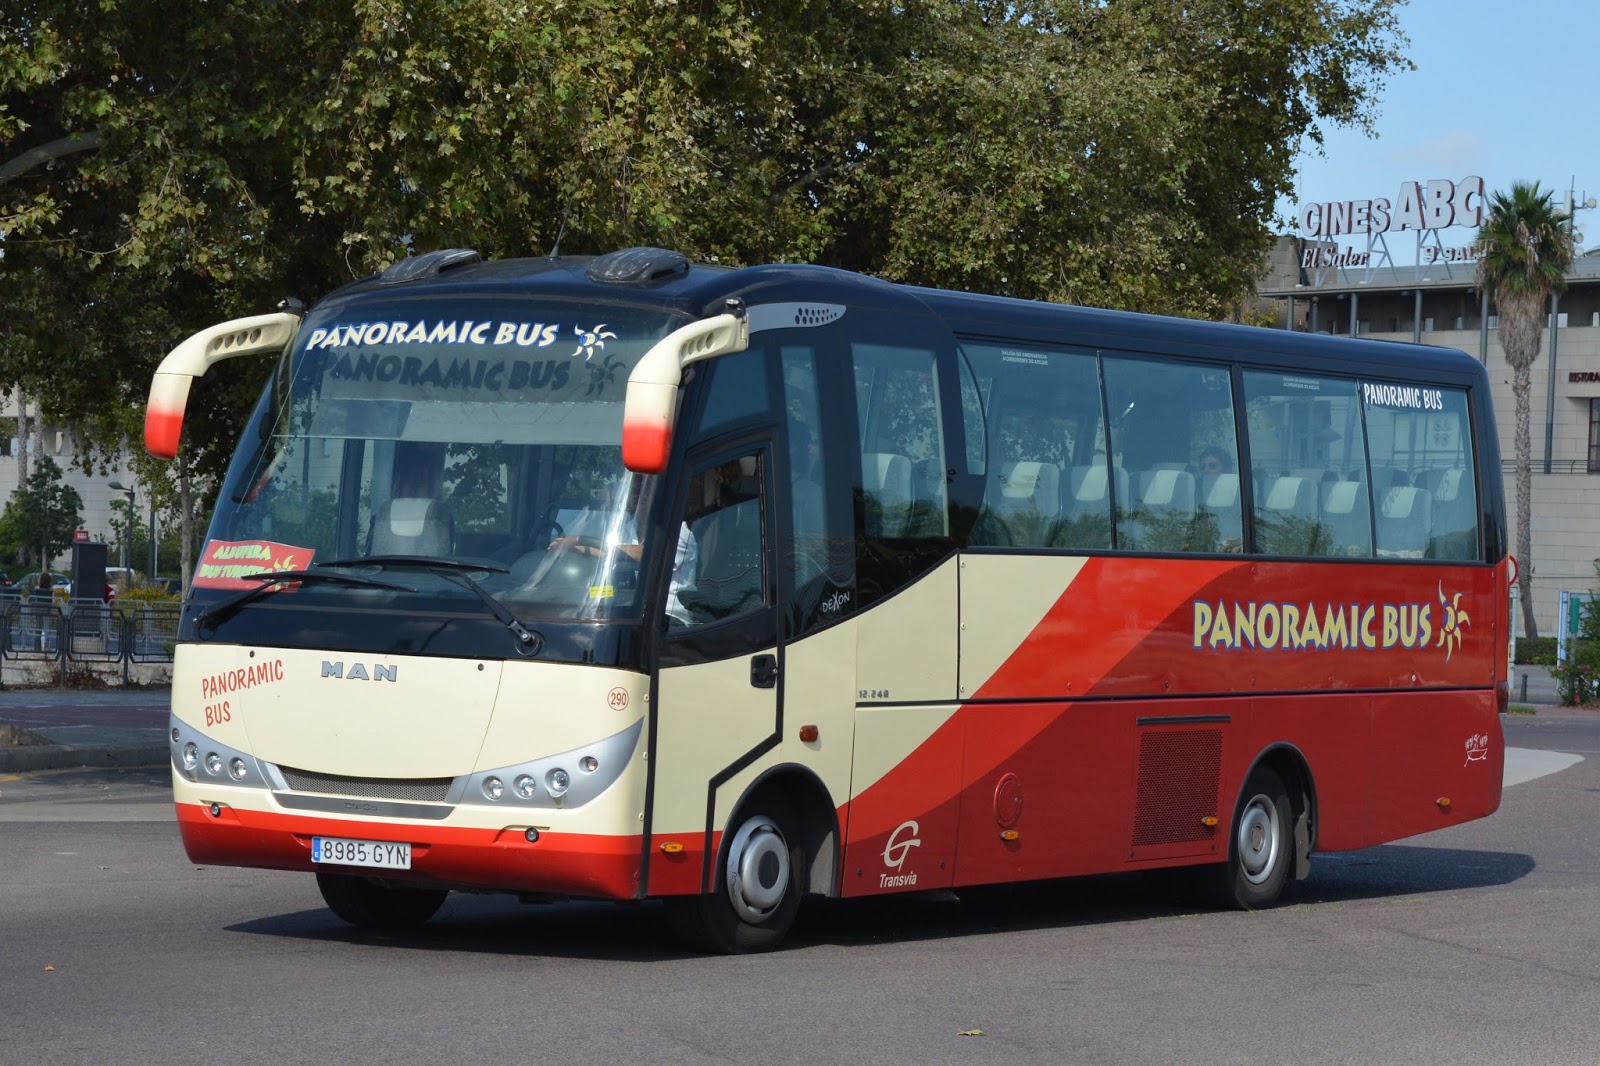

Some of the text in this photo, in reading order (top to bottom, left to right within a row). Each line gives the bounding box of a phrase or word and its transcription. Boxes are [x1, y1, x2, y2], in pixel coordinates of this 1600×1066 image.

[1301, 176, 1484, 237] CINES ABC
[1302, 246, 1370, 268] El Saler
[1423, 246, 1438, 263] 9
[306, 319, 560, 351] PANORAMIC BUS
[1363, 383, 1443, 411] PANORAMIC BUS
[1192, 599, 1433, 650] PANORAMIC BUS
[202, 659, 284, 699] PANORAMIC
[321, 660, 398, 682] MAN
[610, 692, 627, 706] 290
[205, 701, 231, 727] BUS
[323, 841, 406, 866] 8985 GYN
[880, 871, 917, 889] Transvia
